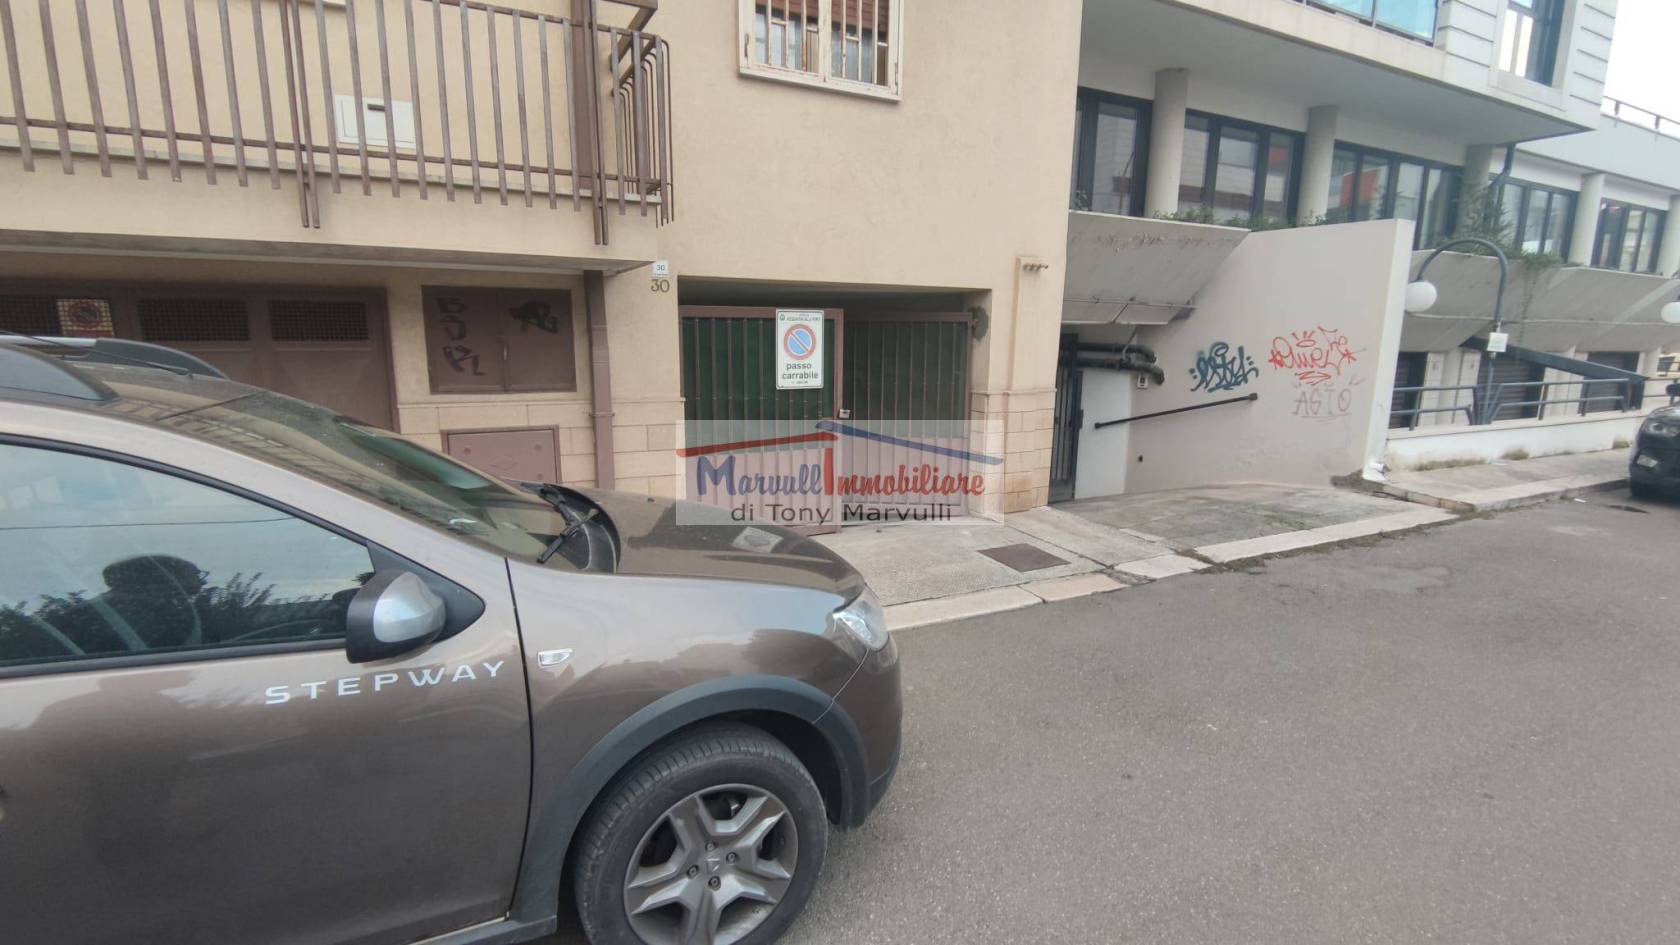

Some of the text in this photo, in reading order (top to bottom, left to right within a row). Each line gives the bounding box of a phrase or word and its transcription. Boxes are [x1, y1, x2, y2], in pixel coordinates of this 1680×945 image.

[656, 264, 666, 272] 30
[651, 279, 670, 293] 30
[786, 362, 812, 371] passo
[782, 371, 819, 380] carrabile
[264, 660, 504, 705] STEPWAY
